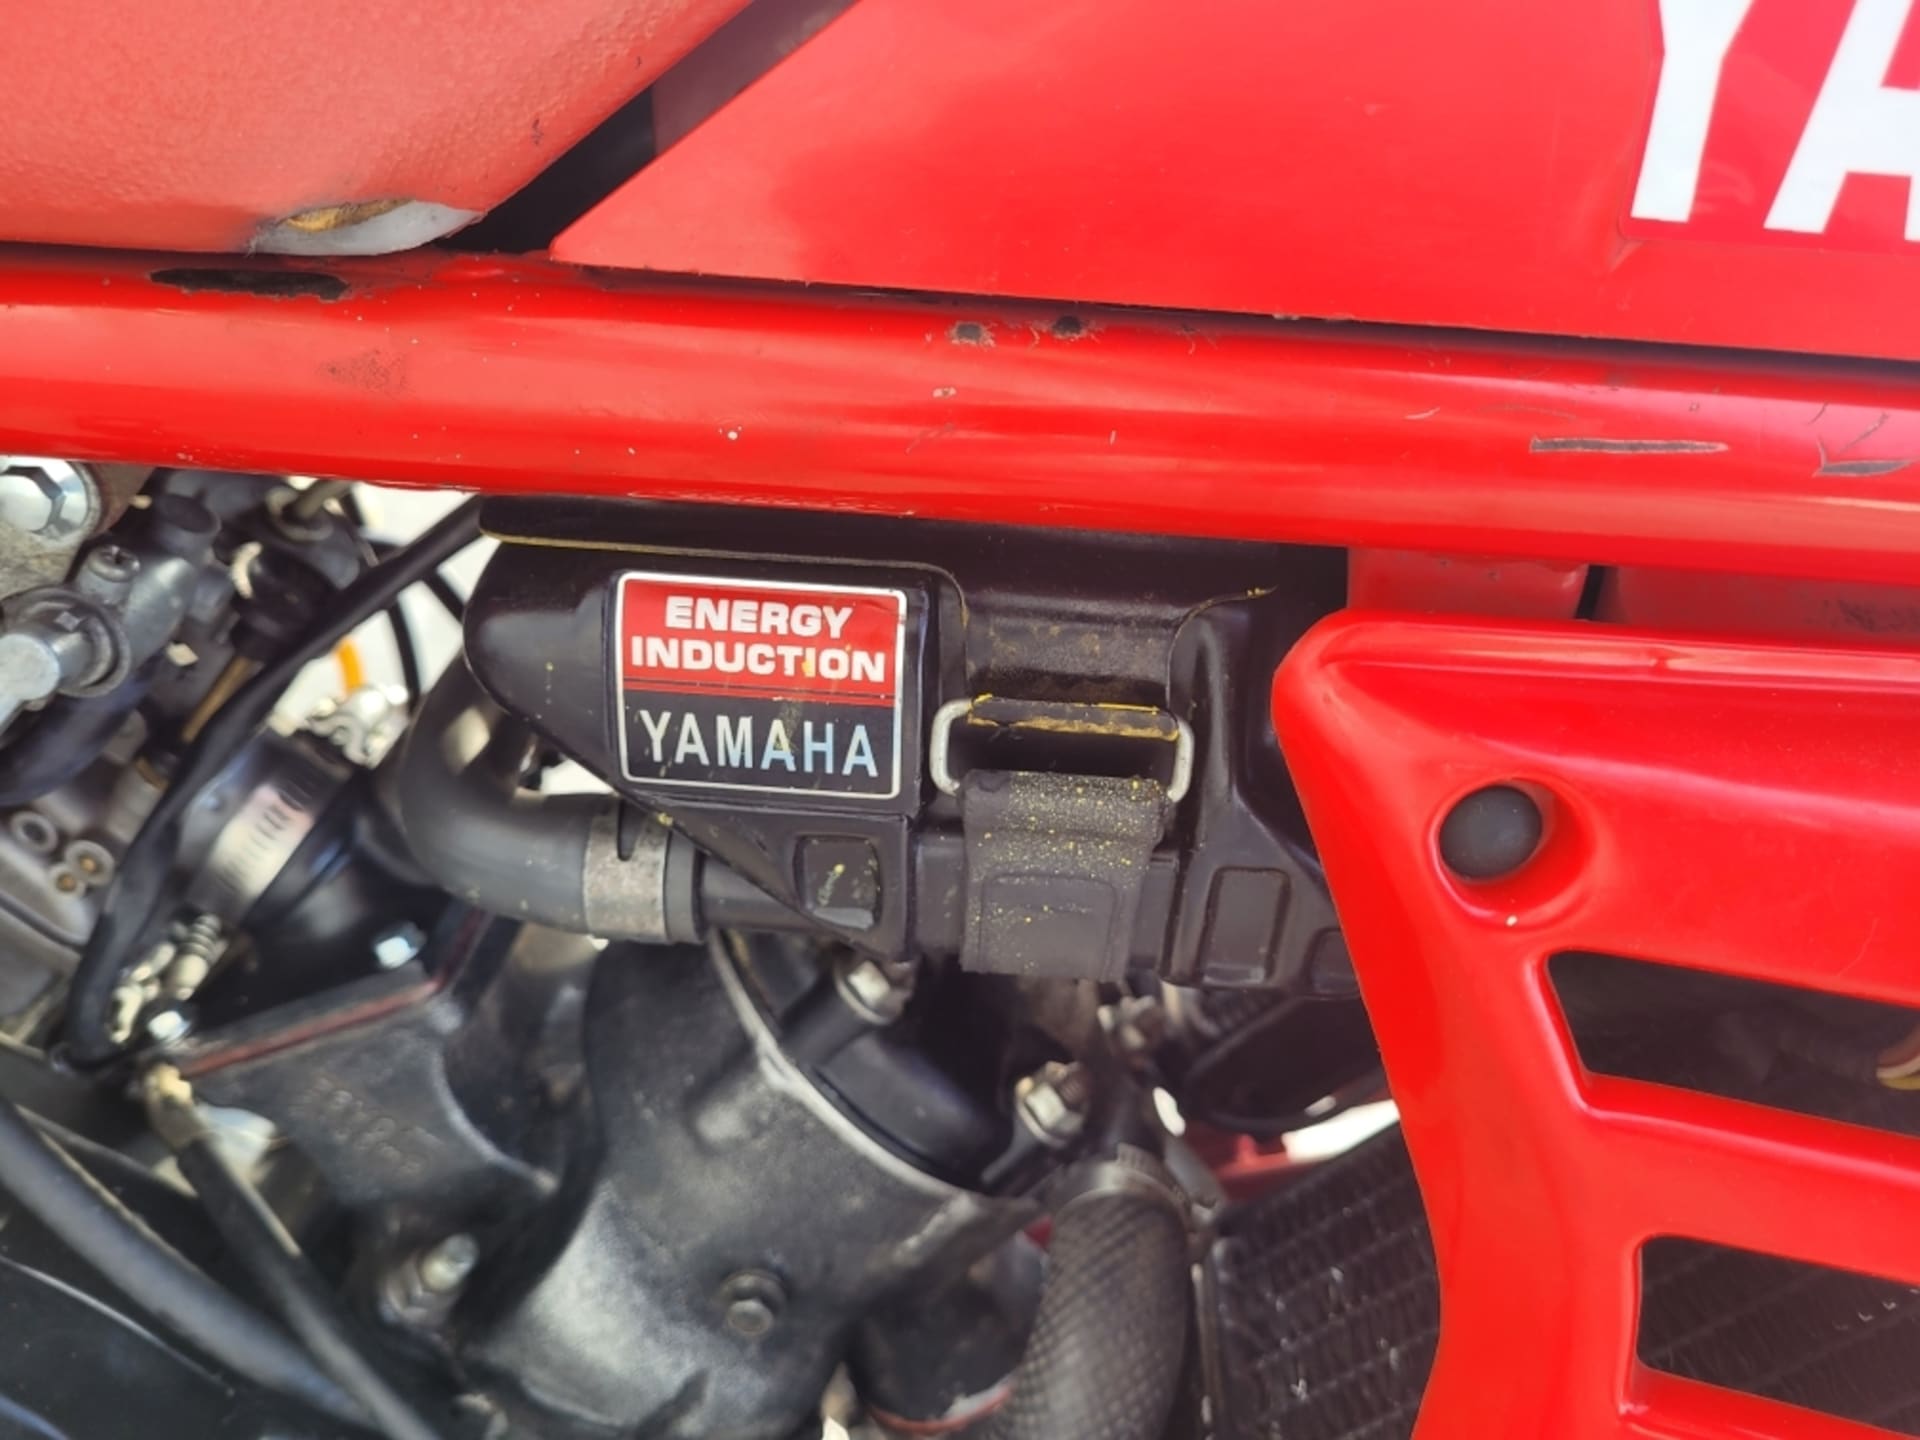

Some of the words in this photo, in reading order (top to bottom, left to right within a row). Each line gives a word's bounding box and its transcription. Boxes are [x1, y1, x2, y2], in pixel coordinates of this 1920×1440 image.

[665, 595, 853, 639] ENERGY
[630, 635, 886, 683] INDUCTION
[639, 709, 879, 778] YAMAHA
